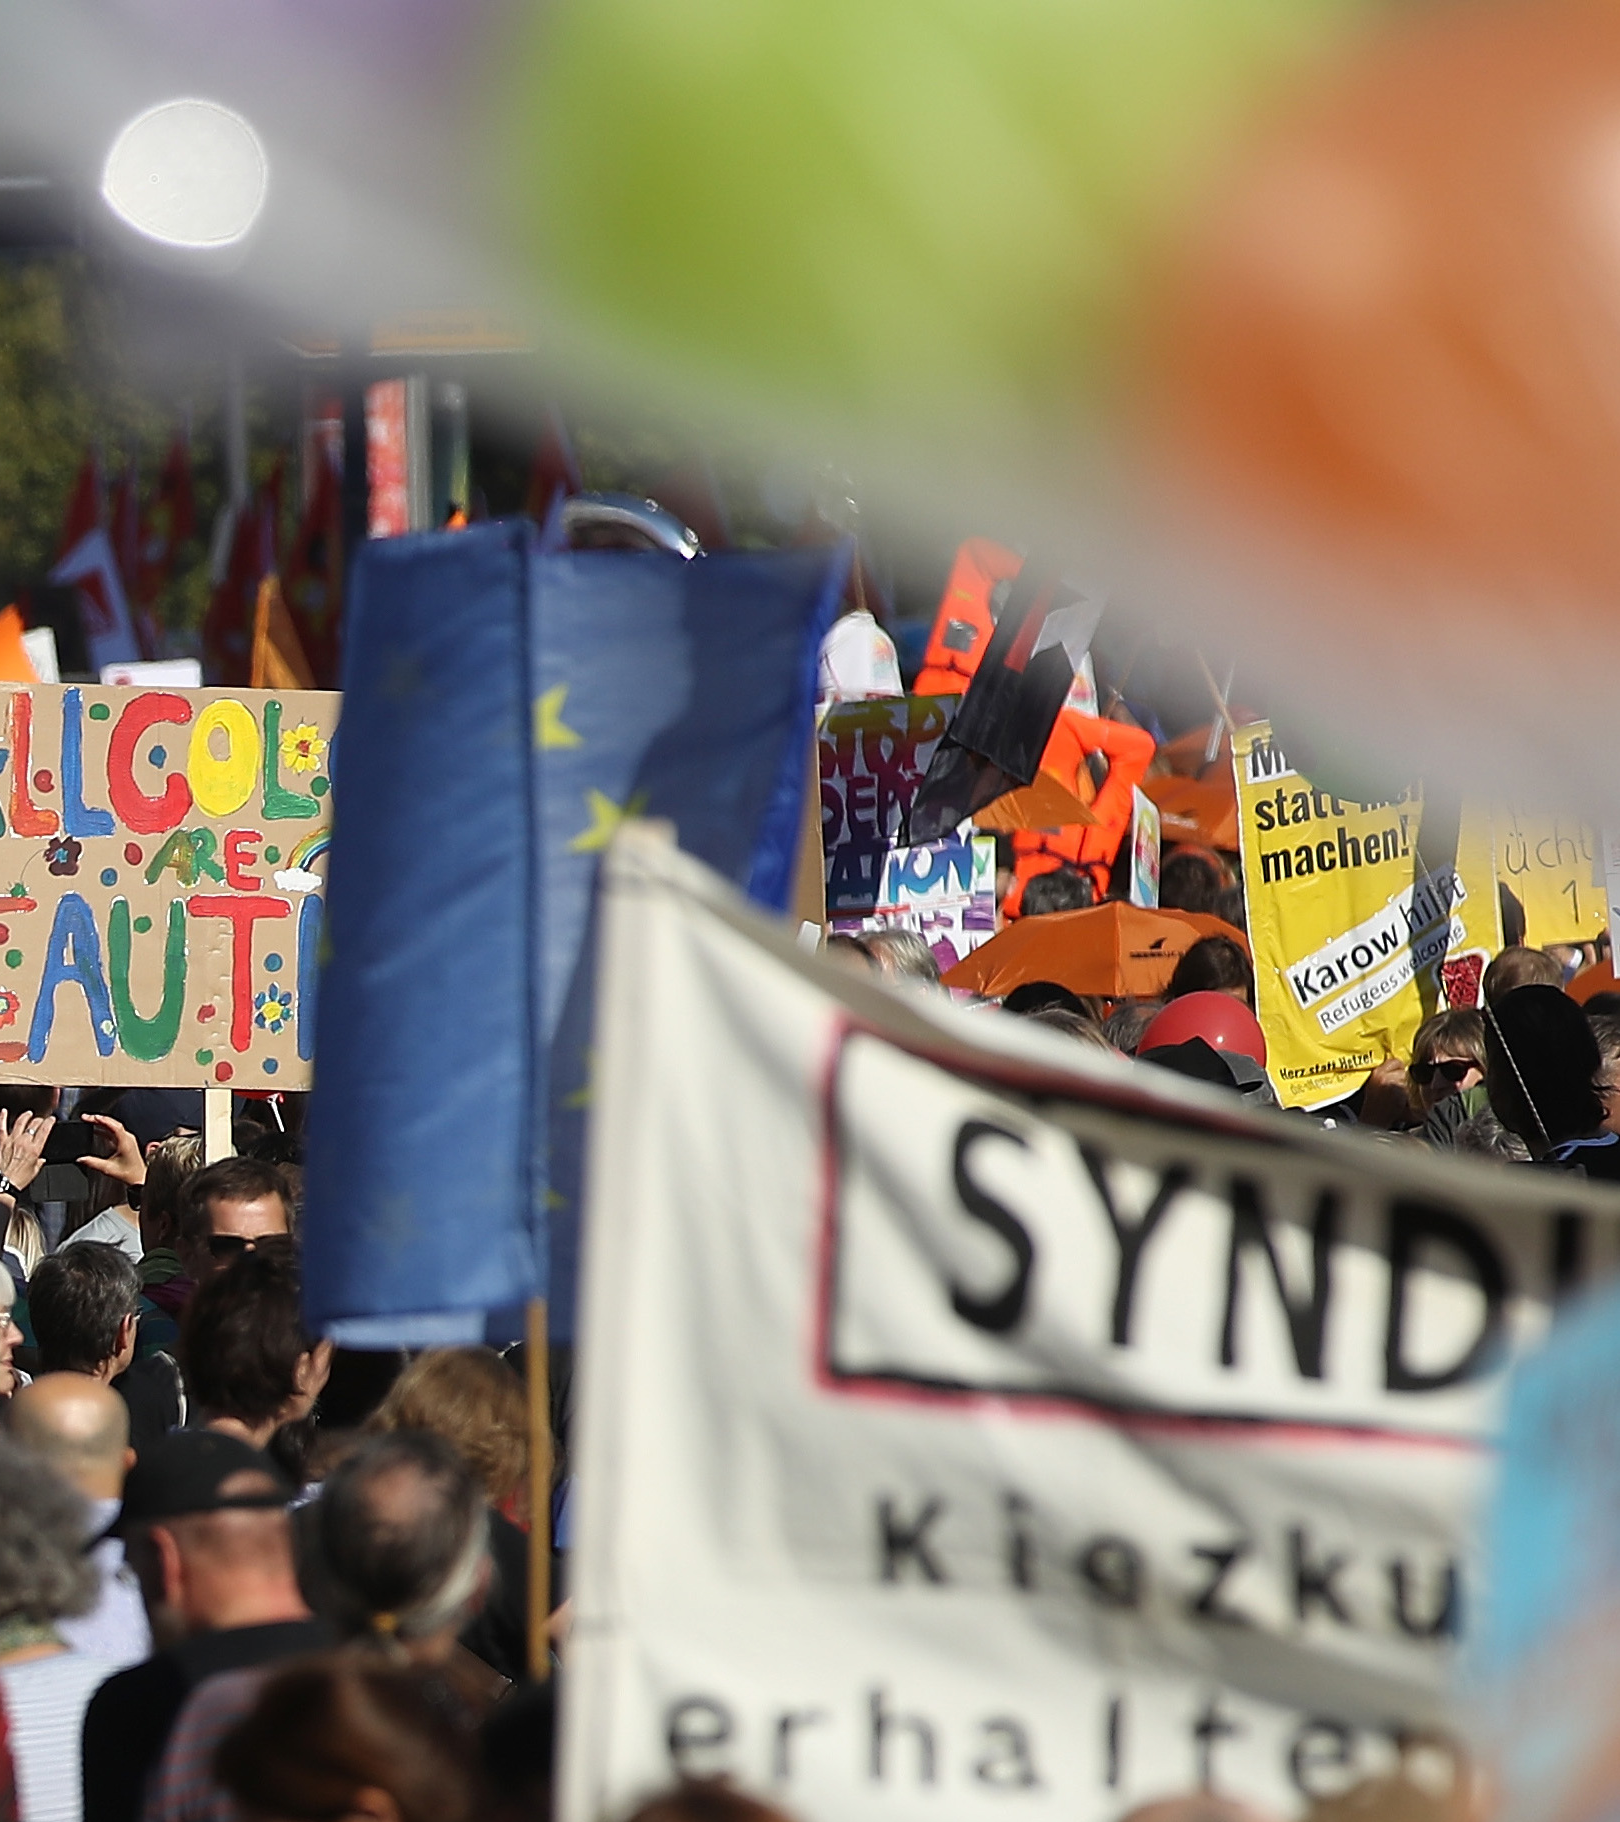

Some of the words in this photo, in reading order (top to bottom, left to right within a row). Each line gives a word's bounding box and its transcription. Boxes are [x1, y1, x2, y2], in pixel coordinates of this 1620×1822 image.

[143, 827, 264, 892] ARE
[1261, 815, 1411, 884] machen!
[1293, 922, 1399, 1003] Karow
[1398, 872, 1467, 934] hilft
[1321, 973, 1399, 1029] Refugees
[1398, 925, 1464, 980] welcome
[1280, 1067, 1306, 1080] Herz
[877, 1491, 1463, 1642] Kiezku
